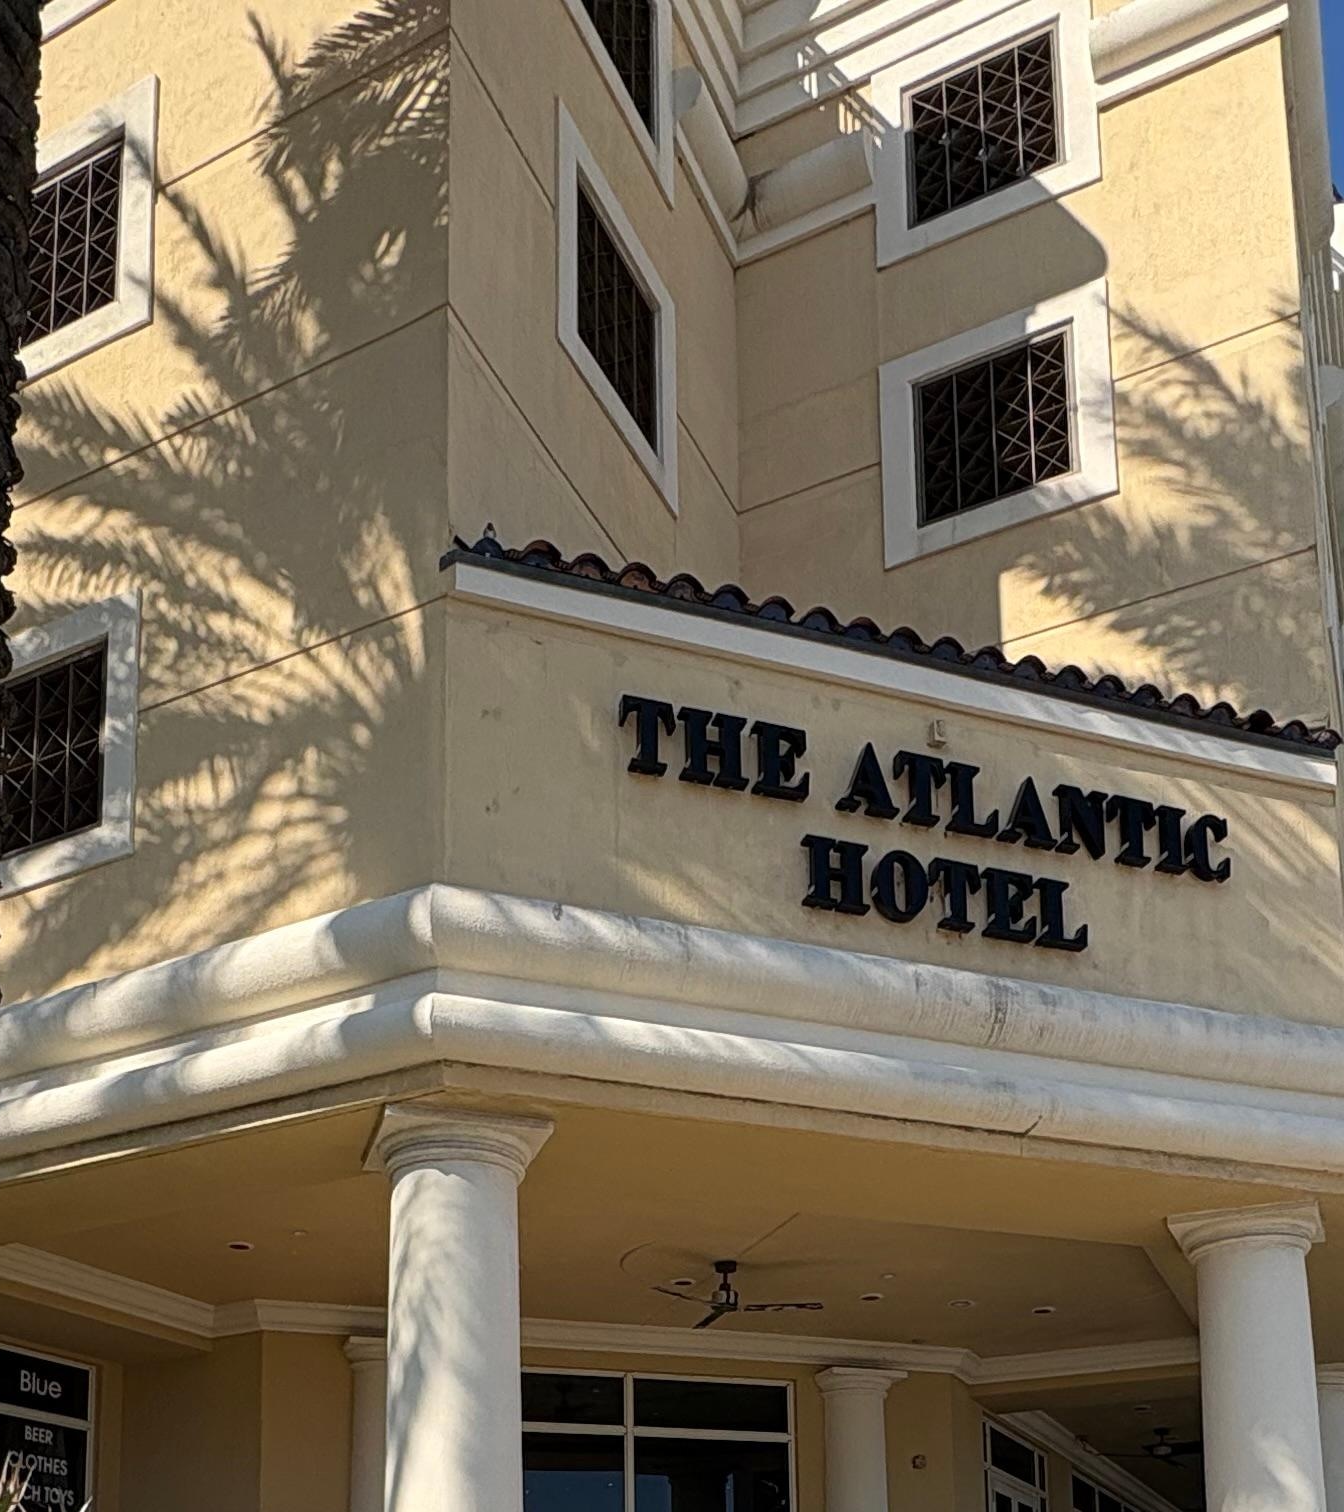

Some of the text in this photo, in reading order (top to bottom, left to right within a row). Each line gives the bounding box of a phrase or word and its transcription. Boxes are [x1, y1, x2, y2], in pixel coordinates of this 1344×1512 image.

[618, 694, 1232, 883] THE ATLANTIC
[800, 834, 1089, 953] HOTEL
[20, 1369, 62, 1399] Blue
[24, 1425, 54, 1445] BEER
[8, 1450, 68, 1476] CLOTHES
[44, 1485, 75, 1506] TOYS
